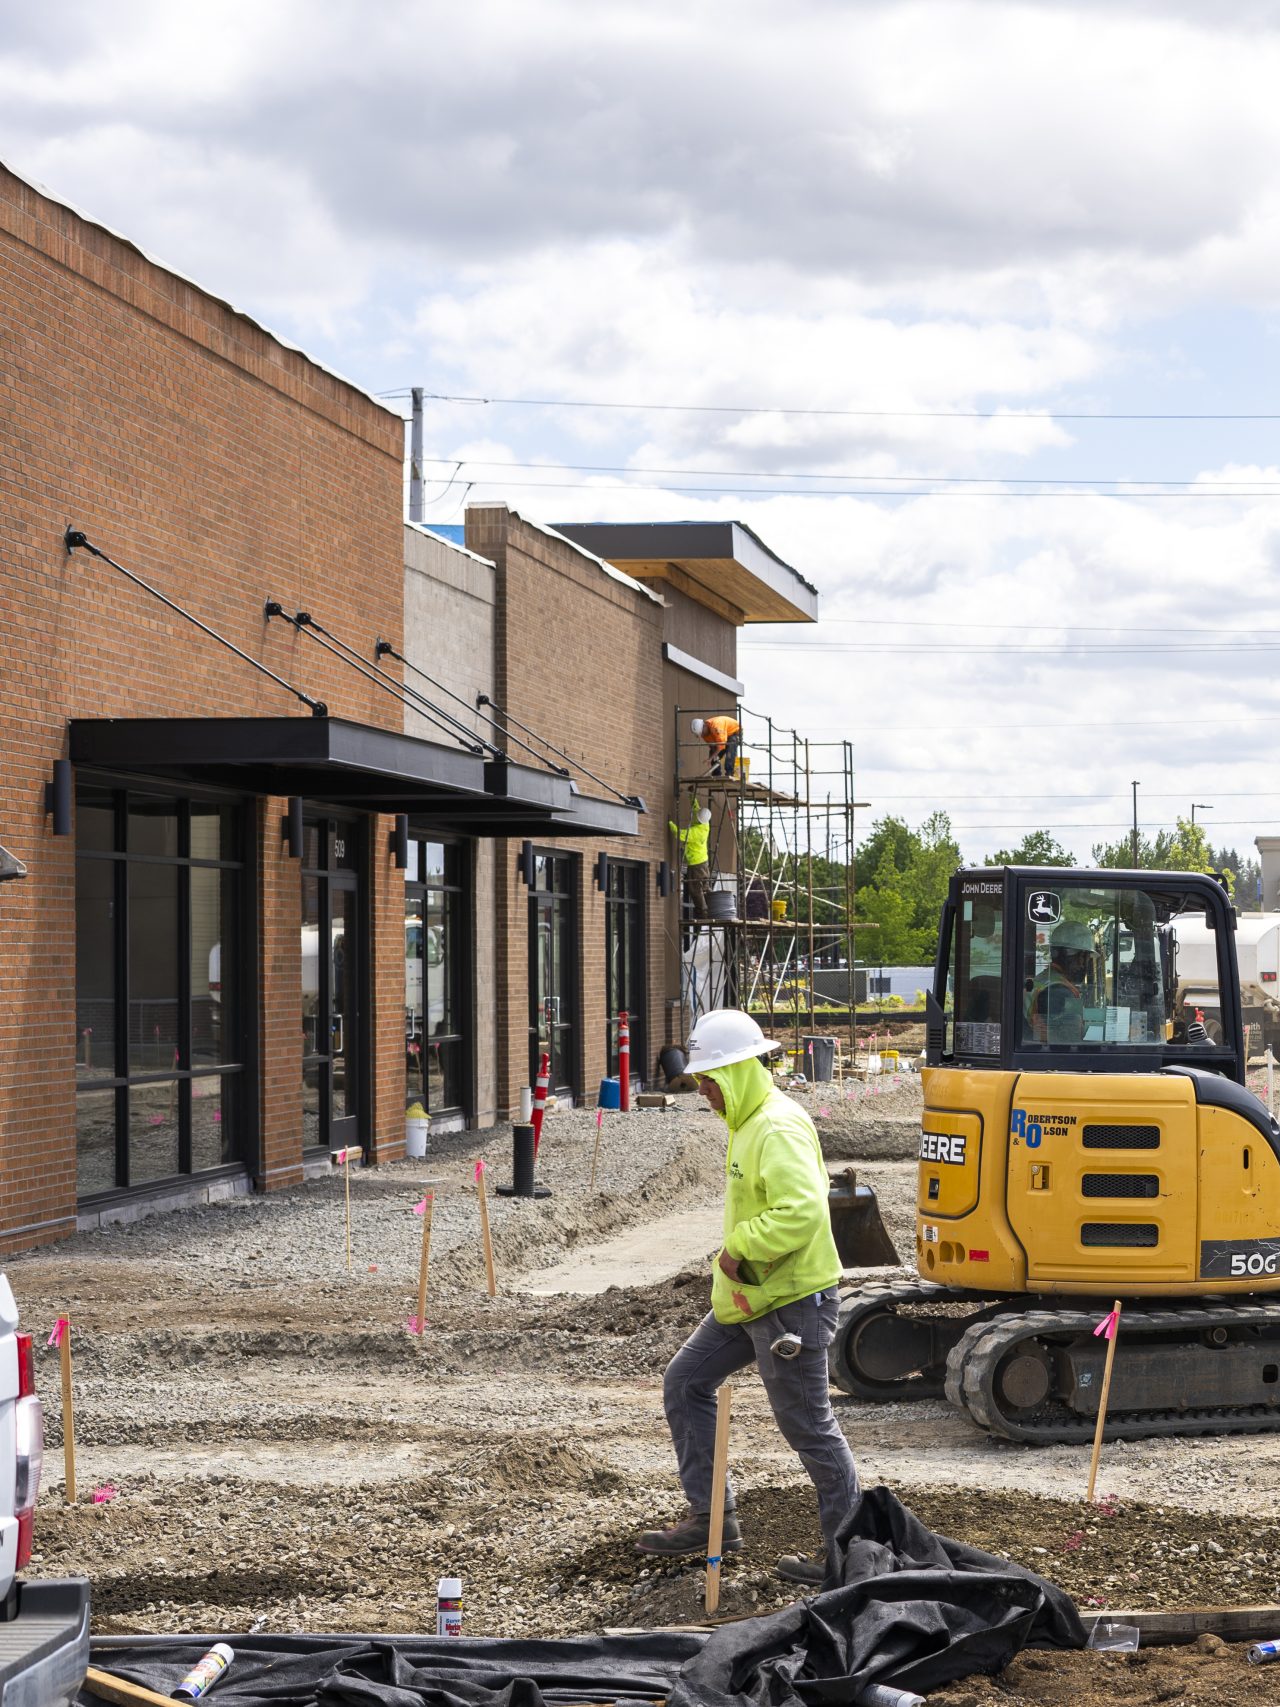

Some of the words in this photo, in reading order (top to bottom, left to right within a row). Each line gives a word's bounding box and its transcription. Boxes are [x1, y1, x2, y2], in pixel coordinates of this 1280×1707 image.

[961, 882, 980, 894] JOHN
[980, 882, 1003, 894] DEERE
[1026, 1123, 1068, 1149] OLSON
[919, 1134, 965, 1163] EERE
[1230, 1253, 1276, 1275] 50G
